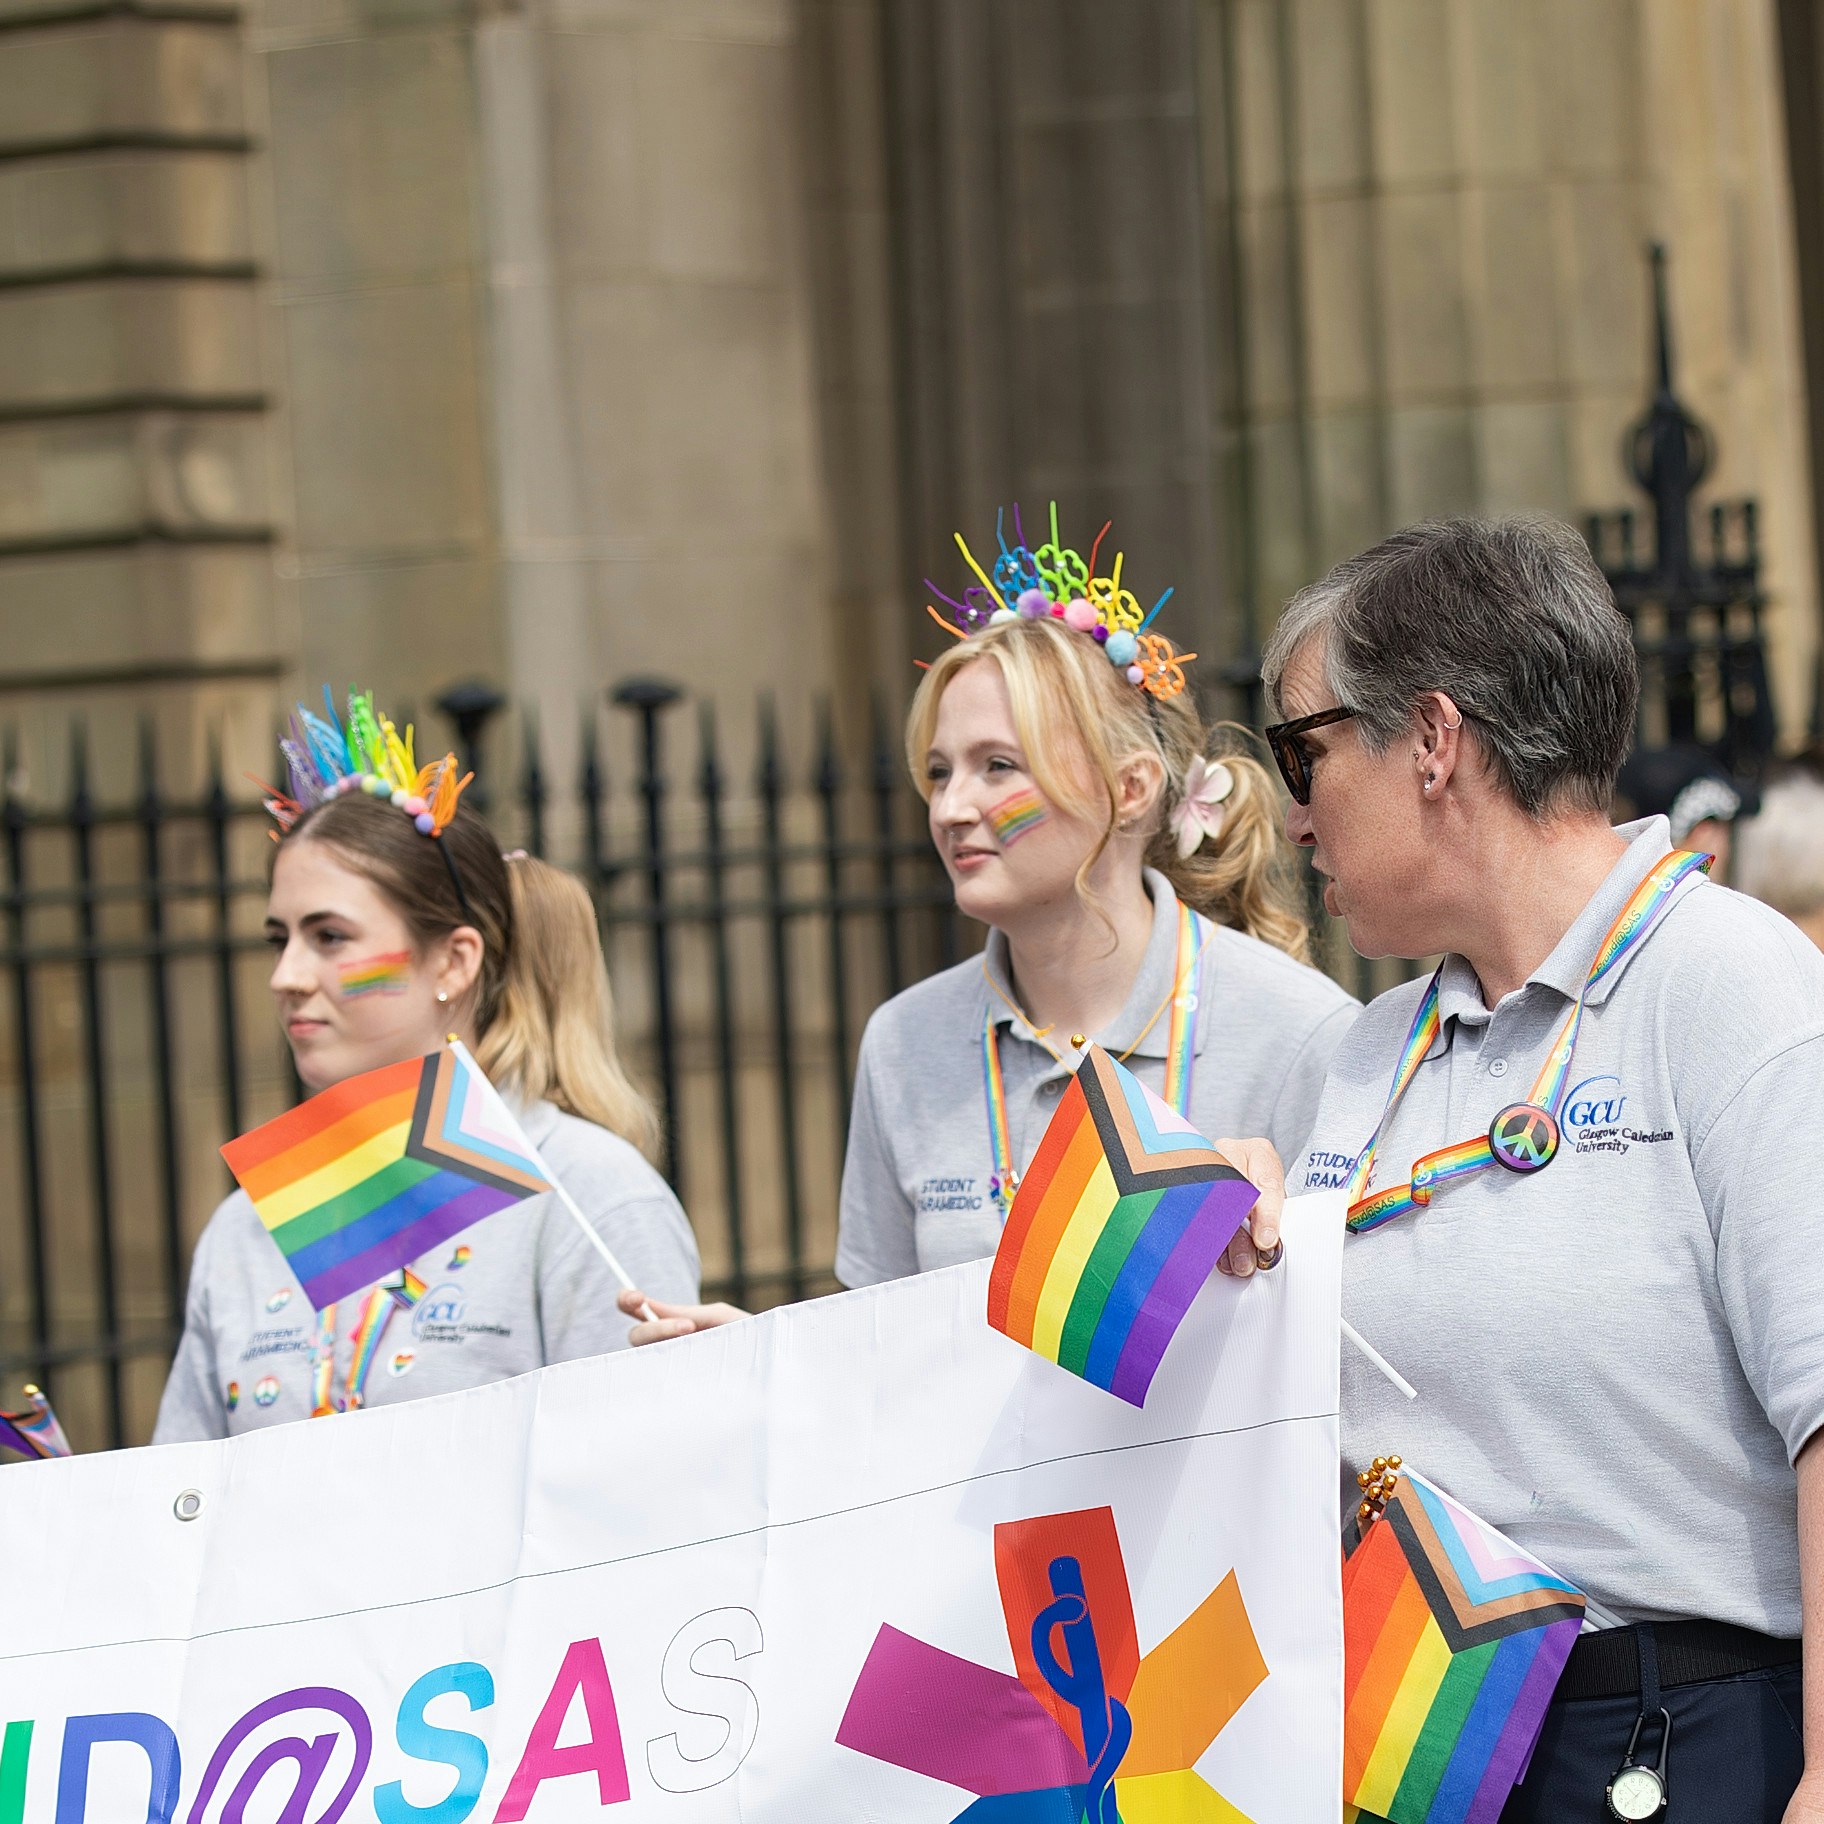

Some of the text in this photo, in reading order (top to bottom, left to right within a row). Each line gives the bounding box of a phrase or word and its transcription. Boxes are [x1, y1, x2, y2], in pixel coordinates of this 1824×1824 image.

[1596, 908, 1642, 973] Proud@SAS
[1569, 1096, 1627, 1126] GCU
[1576, 1139, 1630, 1155] University
[1579, 1127, 1619, 1141] Glasgow
[1348, 1194, 1396, 1227] roud@SAS
